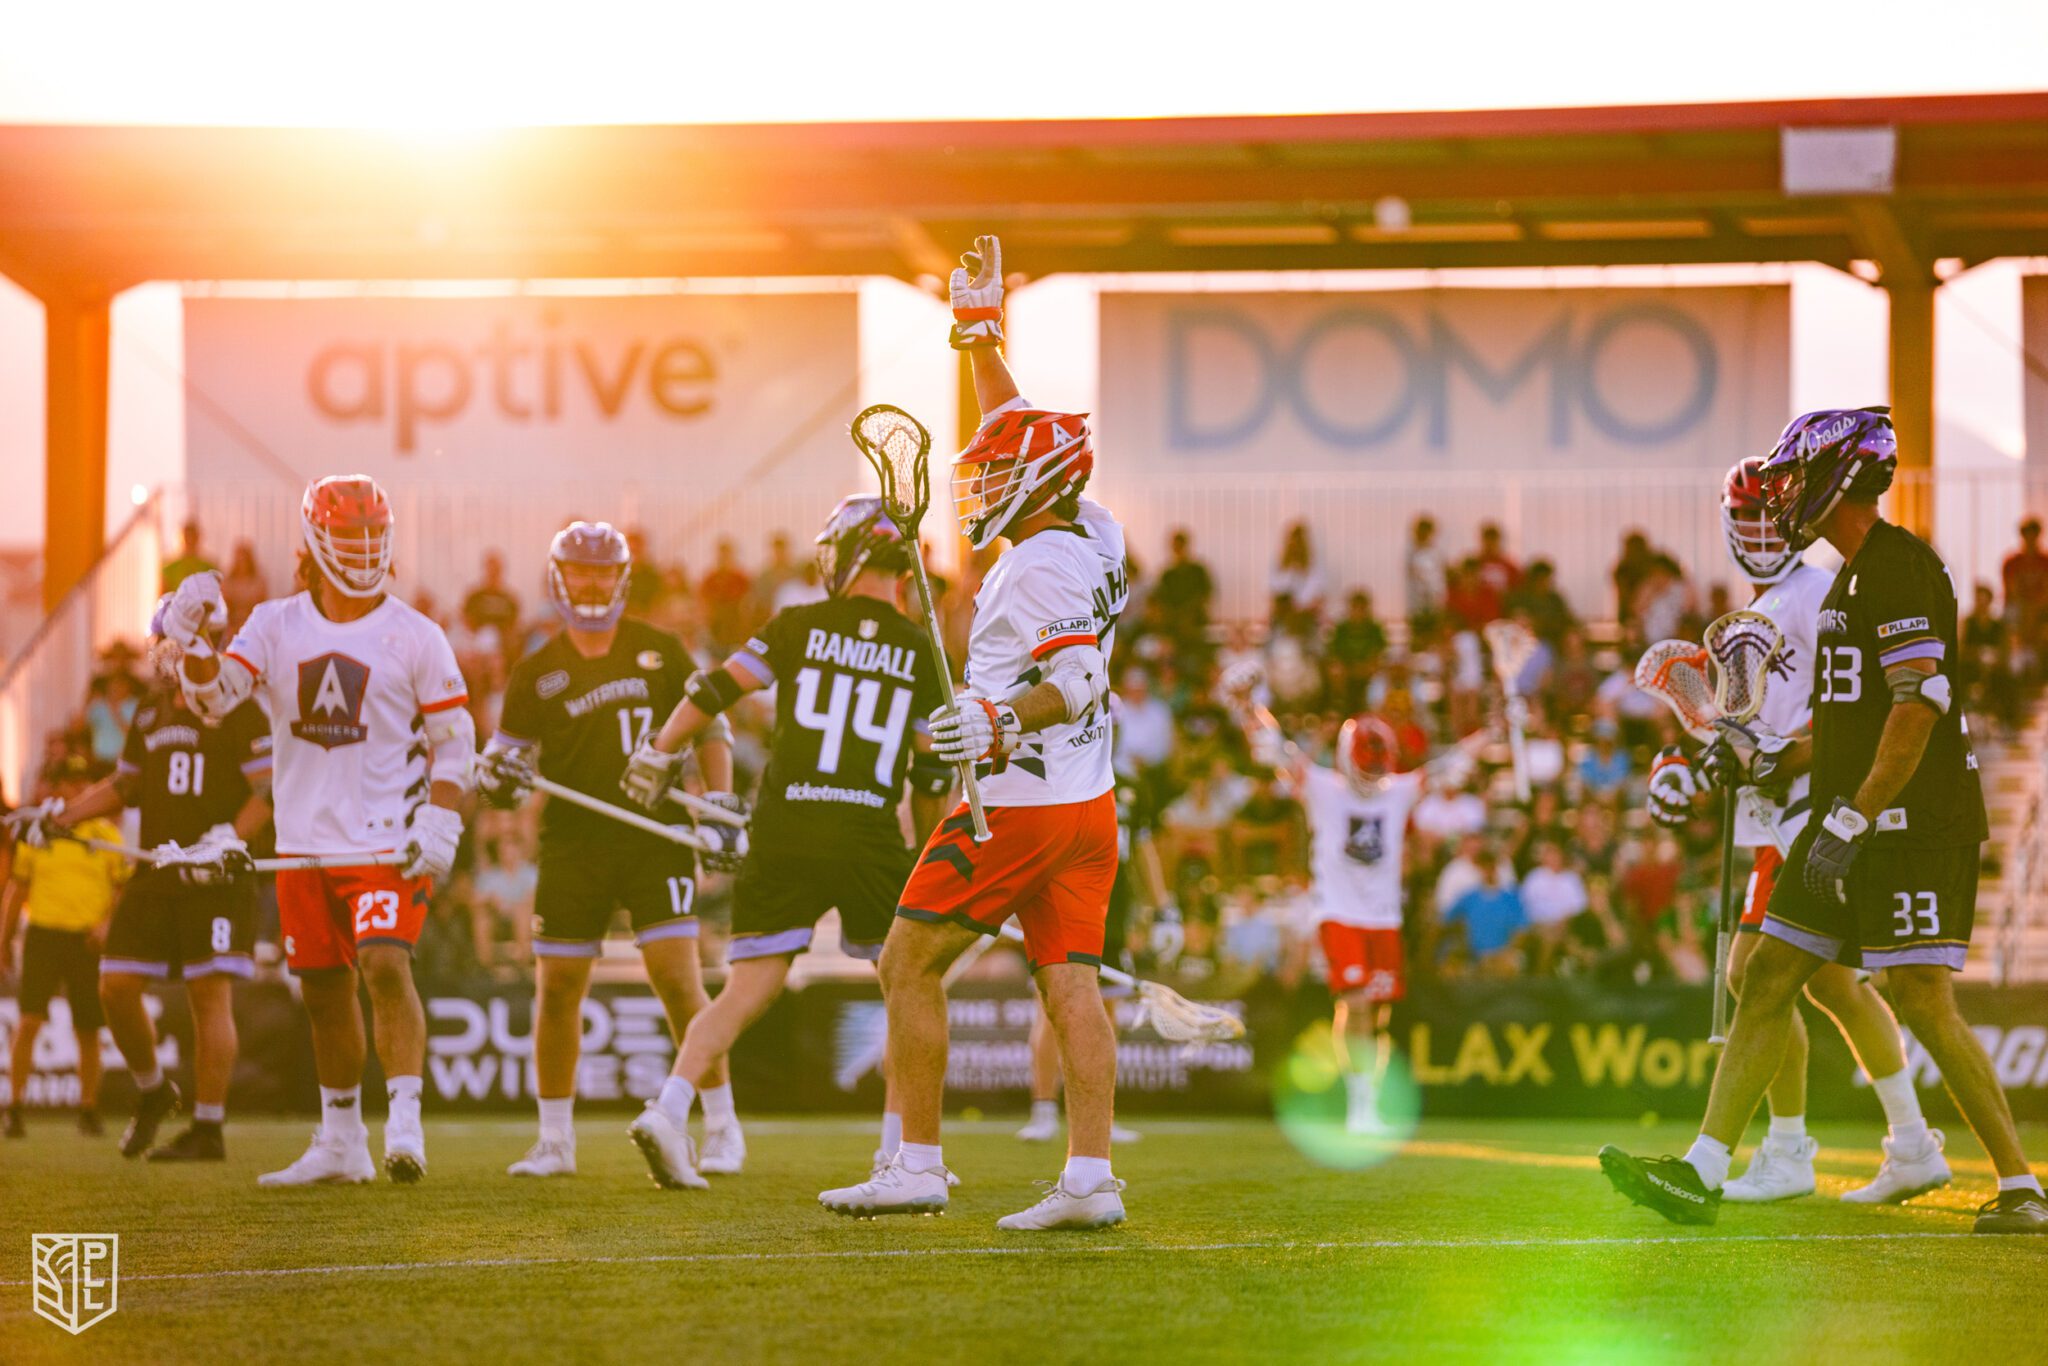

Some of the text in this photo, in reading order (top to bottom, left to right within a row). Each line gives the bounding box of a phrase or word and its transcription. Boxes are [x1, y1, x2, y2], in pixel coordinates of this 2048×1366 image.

[307, 312, 719, 454] aptive
[1166, 303, 1719, 450] DOMO
[1806, 416, 1857, 462] Dogs
[1048, 620, 1089, 635] PLL.APP
[805, 628, 916, 683] RANDALL
[1820, 646, 1862, 703] 33
[302, 724, 359, 739] ARCHERS
[617, 706, 653, 756] 17
[794, 667, 913, 788] 44
[168, 751, 205, 797] 81
[785, 782, 887, 809] ticketmaster
[355, 890, 399, 934] 23
[667, 876, 694, 915] 17
[1893, 891, 1940, 937] 33
[211, 916, 231, 954] 8
[427, 997, 674, 1055] DUDE
[427, 1053, 671, 1100] WIES
[1410, 1022, 1720, 1088] LAX Wor
[1663, 1180, 1706, 1205] balance
